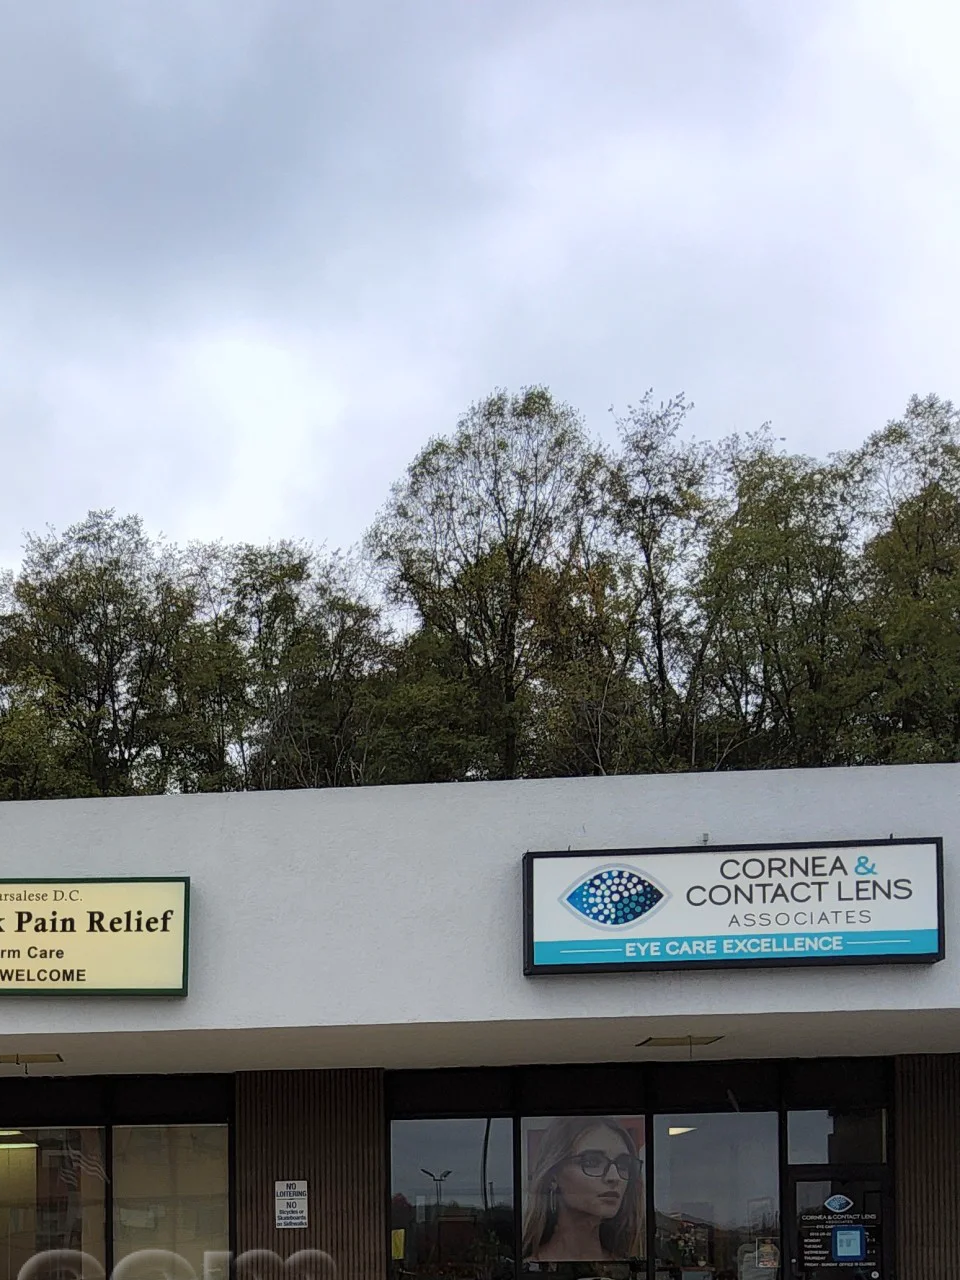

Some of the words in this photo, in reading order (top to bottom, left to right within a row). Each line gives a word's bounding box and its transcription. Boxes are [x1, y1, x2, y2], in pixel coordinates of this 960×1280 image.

[719, 856, 848, 880] CORNEA
[854, 855, 878, 876] &
[53, 889, 83, 902] D.C.
[686, 881, 829, 907] CONTACT
[837, 878, 913, 902] LENS
[14, 910, 76, 933] Pain
[86, 909, 174, 933] Relief
[727, 909, 872, 928] ASSOCIATES
[27, 945, 65, 959] Care
[625, 941, 661, 957] EYE
[669, 939, 717, 956] CARE
[722, 936, 843, 953] EXCELLENCE
[0, 968, 87, 982] WELCOME
